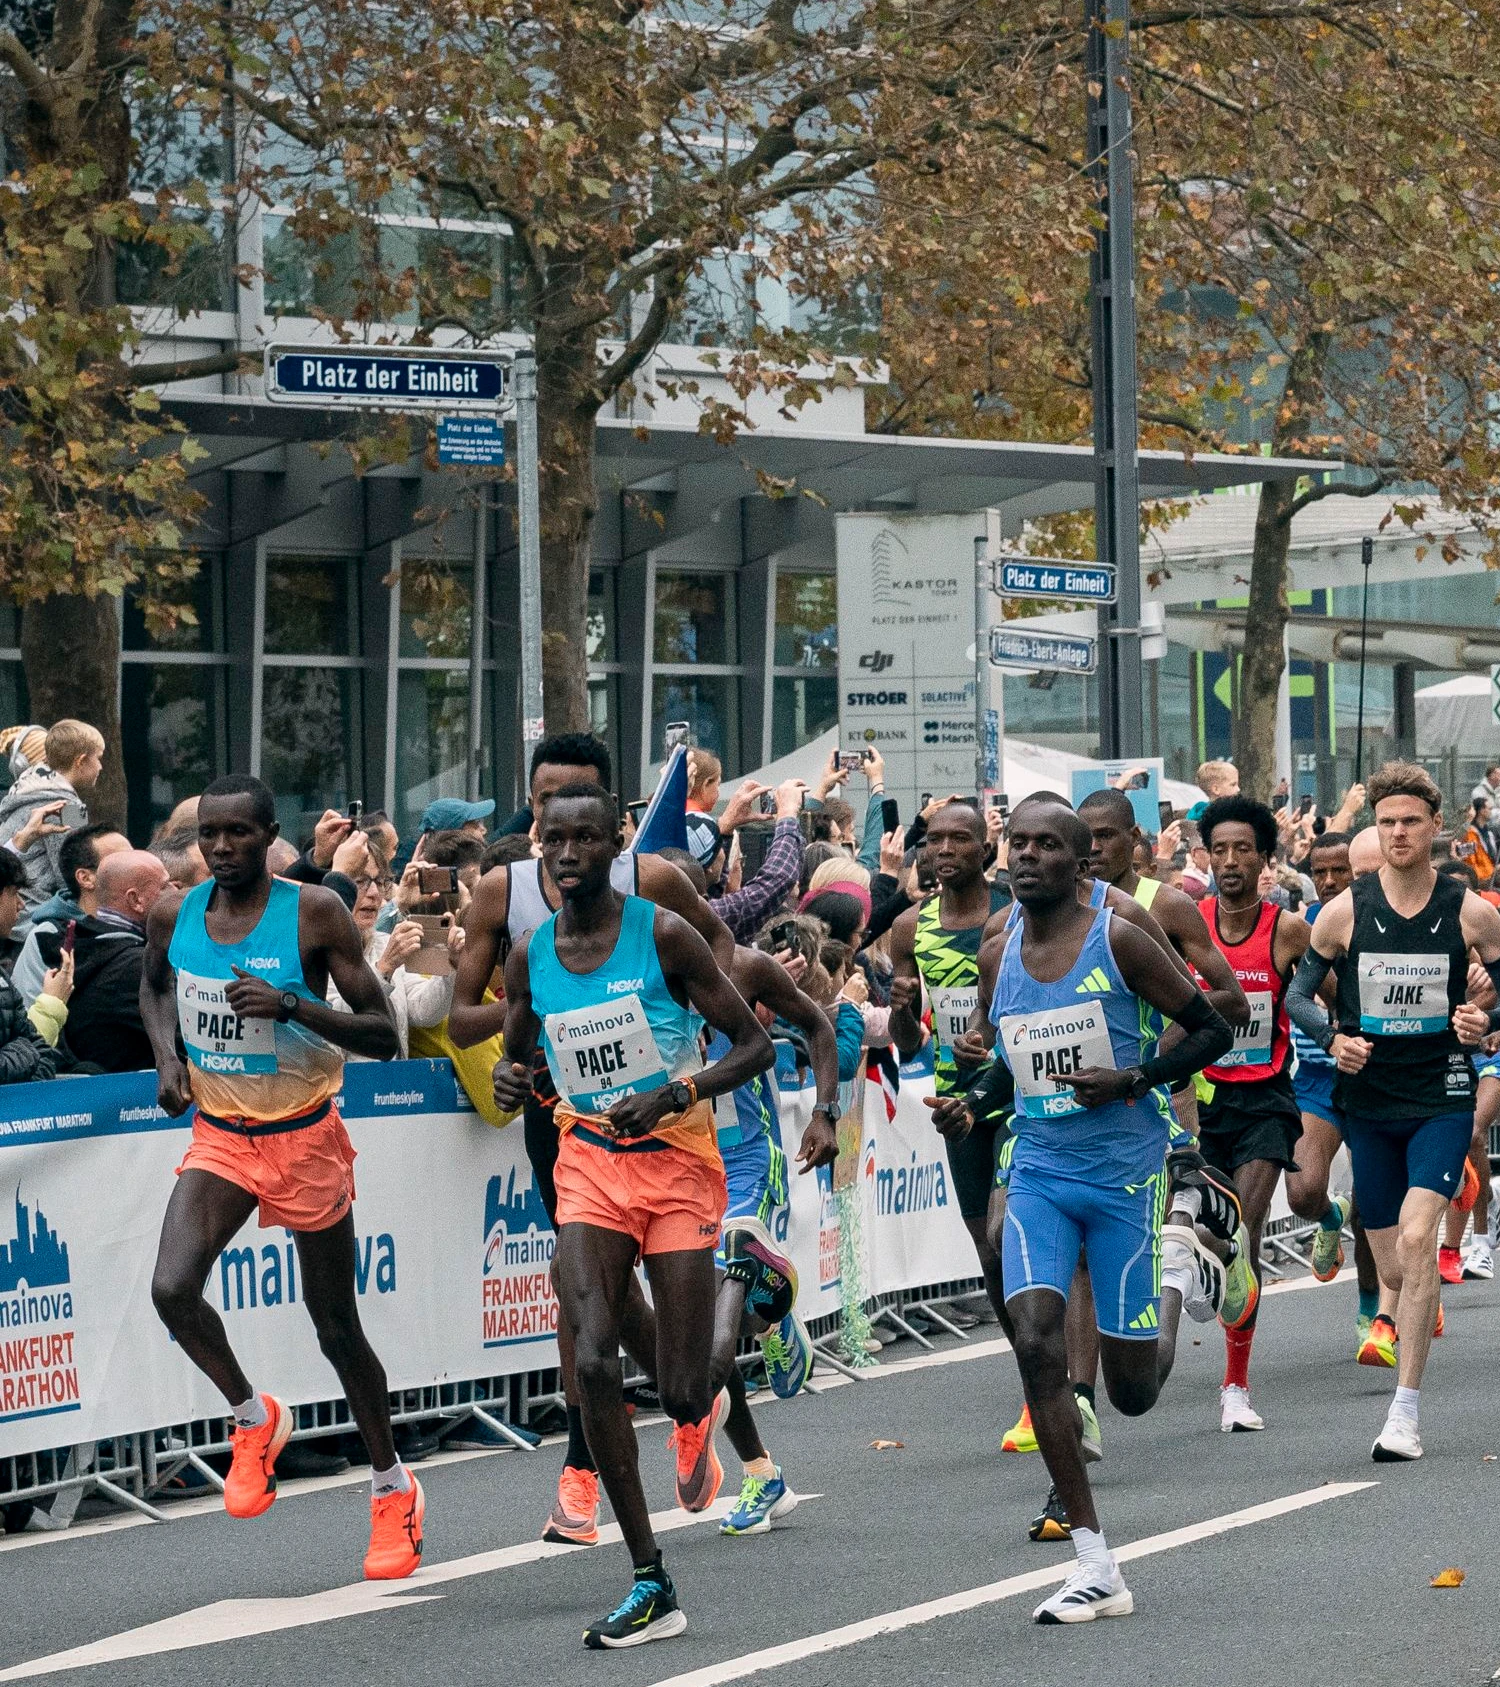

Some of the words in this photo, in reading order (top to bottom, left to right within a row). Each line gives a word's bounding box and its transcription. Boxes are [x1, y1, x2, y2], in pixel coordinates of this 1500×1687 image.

[303, 361, 357, 388] Platz
[366, 363, 400, 390] der
[408, 364, 478, 393] Einheit
[447, 423, 461, 432] Platz
[892, 579, 958, 589] KASTOR
[1006, 567, 1036, 588] Platz
[1040, 572, 1060, 590] der
[1065, 572, 1105, 594] Einheit
[998, 638, 1087, 666] Friedrich-Ebert-Anlage
[847, 691, 908, 706] STRÖER
[921, 692, 967, 702] SOLACTIVE
[848, 732, 861, 741] KT
[877, 730, 908, 741] BANK
[942, 732, 975, 744] Marsh
[245, 957, 280, 969] HOKA
[1385, 964, 1441, 977] mainova
[1235, 969, 1269, 983] SWG
[606, 978, 646, 995] HOKA
[1383, 985, 1424, 1005] JAKE
[196, 1011, 245, 1042] PACE
[568, 1010, 636, 1039] mainova
[1028, 1017, 1096, 1041] mainova
[1382, 1020, 1423, 1034] HOKA
[215, 1042, 226, 1053] 93
[200, 1053, 246, 1072] HOKA
[575, 1040, 628, 1079] PACE
[1032, 1045, 1083, 1081] PACE
[600, 1076, 613, 1090] 94
[374, 1090, 424, 1106] #runtheskyline
[14, 1116, 54, 1134] FRANKFURT
[56, 1112, 93, 1130] MARATHON
[876, 1150, 947, 1216] mainova
[220, 1230, 396, 1311] maiva
